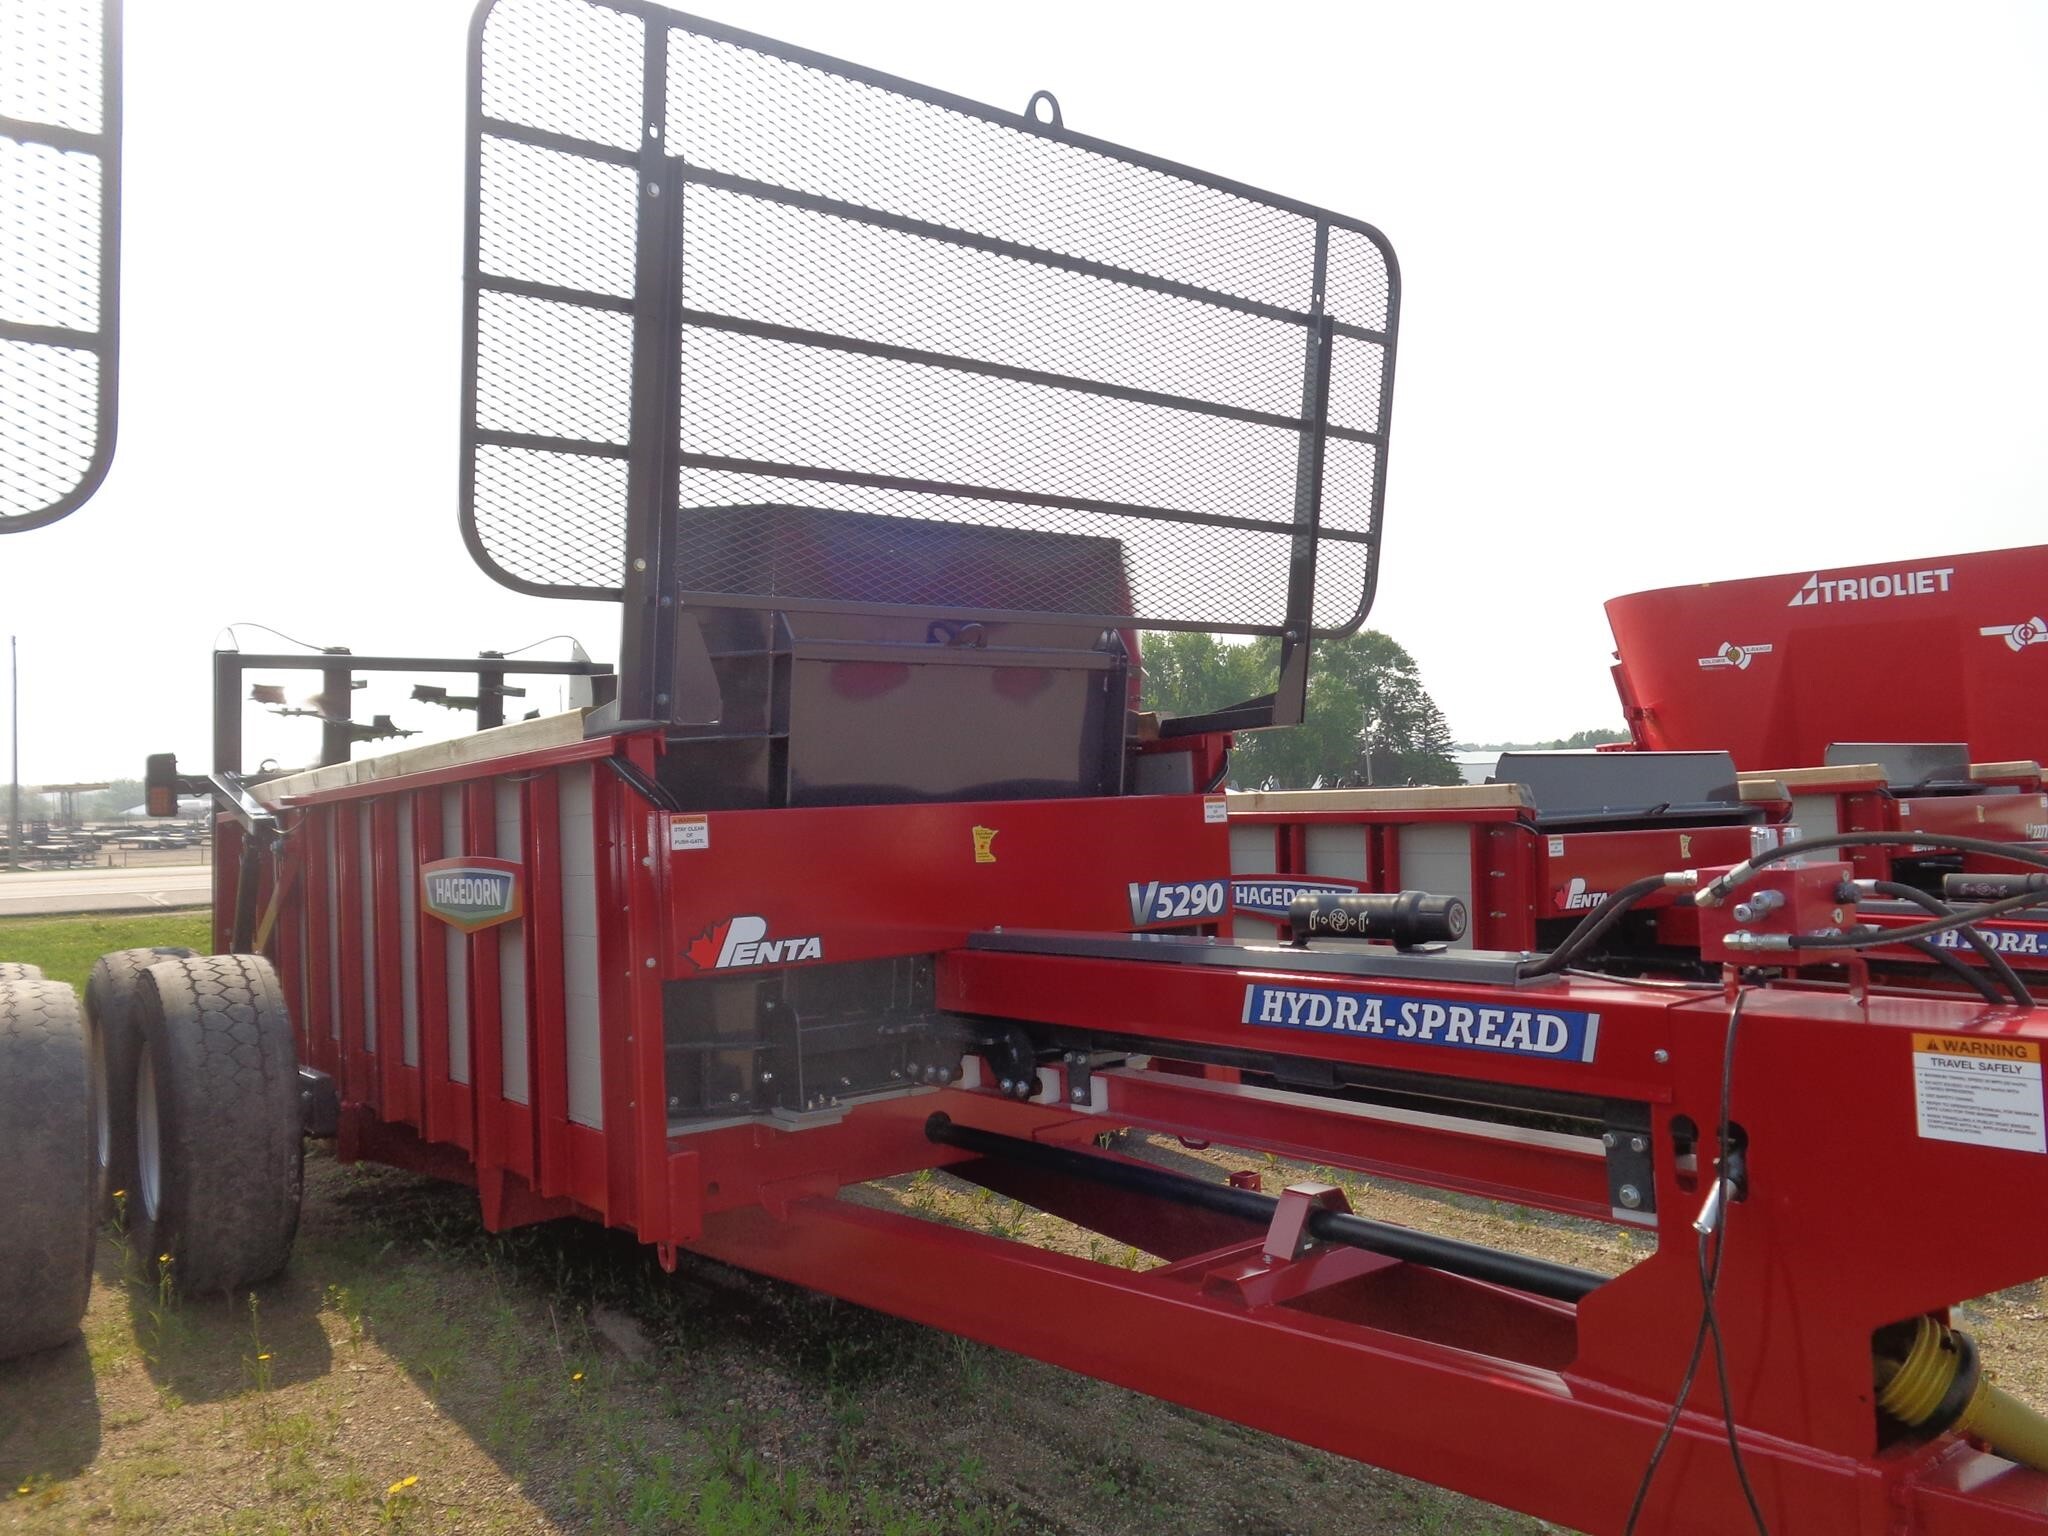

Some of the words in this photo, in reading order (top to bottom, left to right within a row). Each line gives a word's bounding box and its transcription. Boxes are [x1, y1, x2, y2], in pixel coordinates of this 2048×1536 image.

[1819, 568, 1954, 603] TRIOLIET
[435, 878, 501, 906] HAGEDORN
[1128, 881, 1224, 926] V5290
[1235, 886, 1337, 906] HAGED
[715, 916, 822, 969] PENTA
[1259, 989, 1569, 1053] HYDRA-SPREAD
[1943, 1040, 2028, 1059] WARNING
[1930, 1057, 1975, 1070] TRAVEL
[1978, 1062, 2022, 1074] SAFELY
